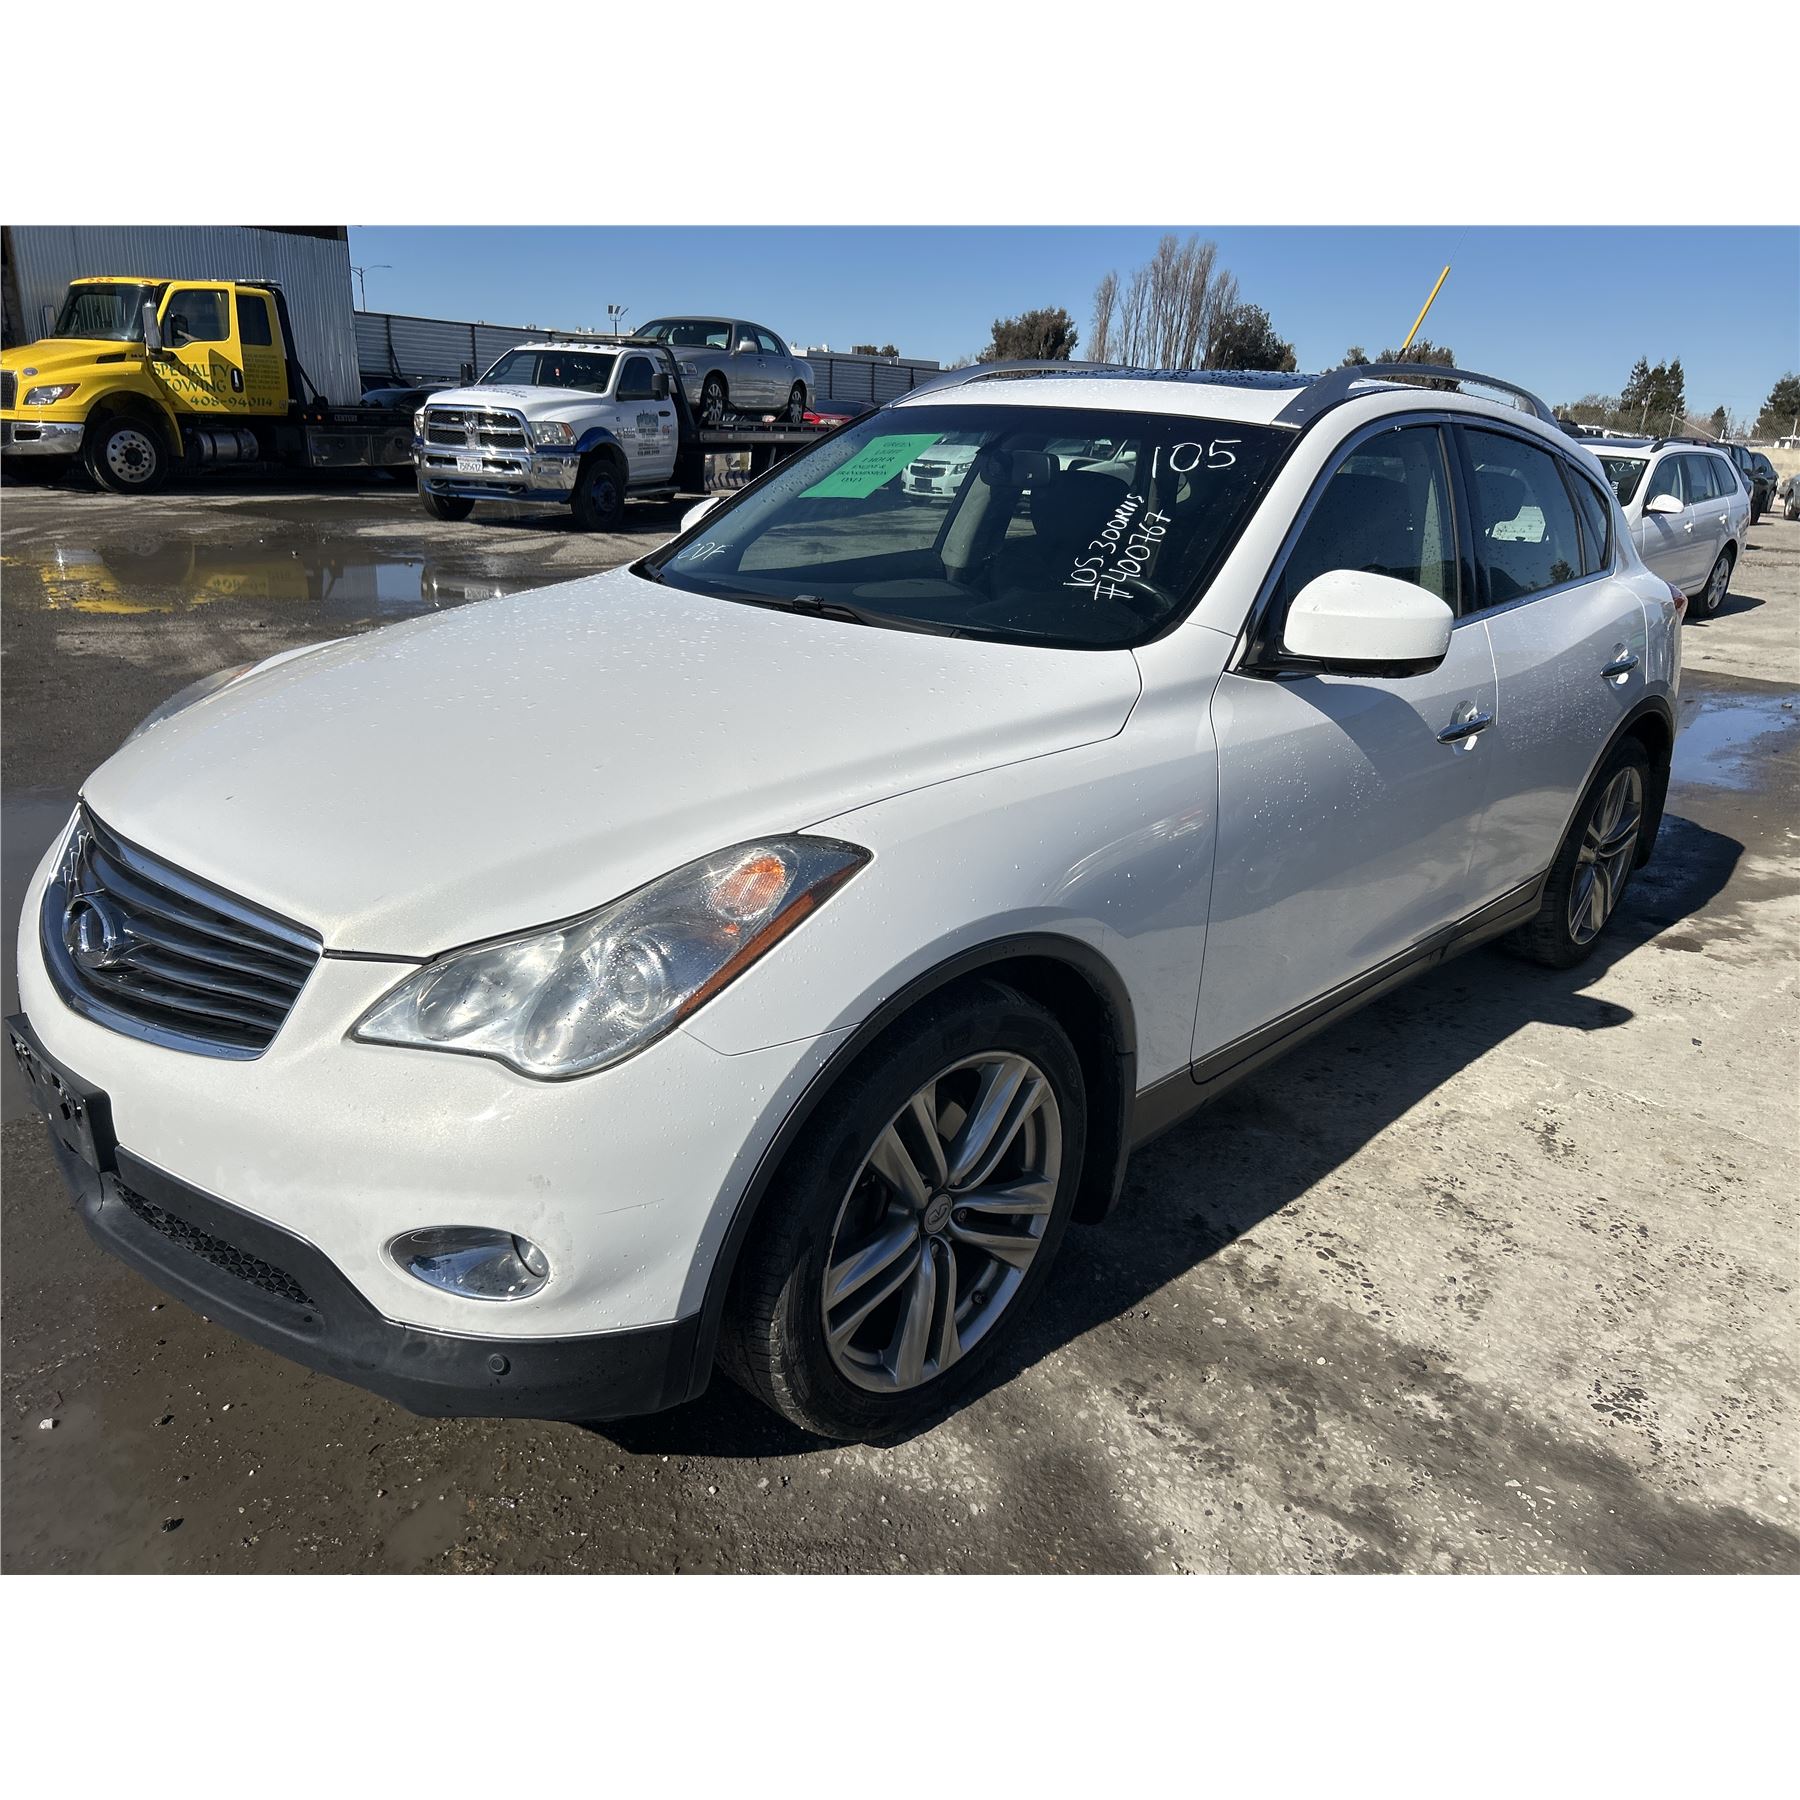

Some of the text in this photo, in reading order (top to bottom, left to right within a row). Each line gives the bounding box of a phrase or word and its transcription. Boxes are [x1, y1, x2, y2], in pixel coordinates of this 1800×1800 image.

[153, 362, 230, 377] SPECIALTY
[165, 378, 226, 393] TOWING
[1151, 439, 1242, 479] 105
[1094, 509, 1172, 601] #400767
